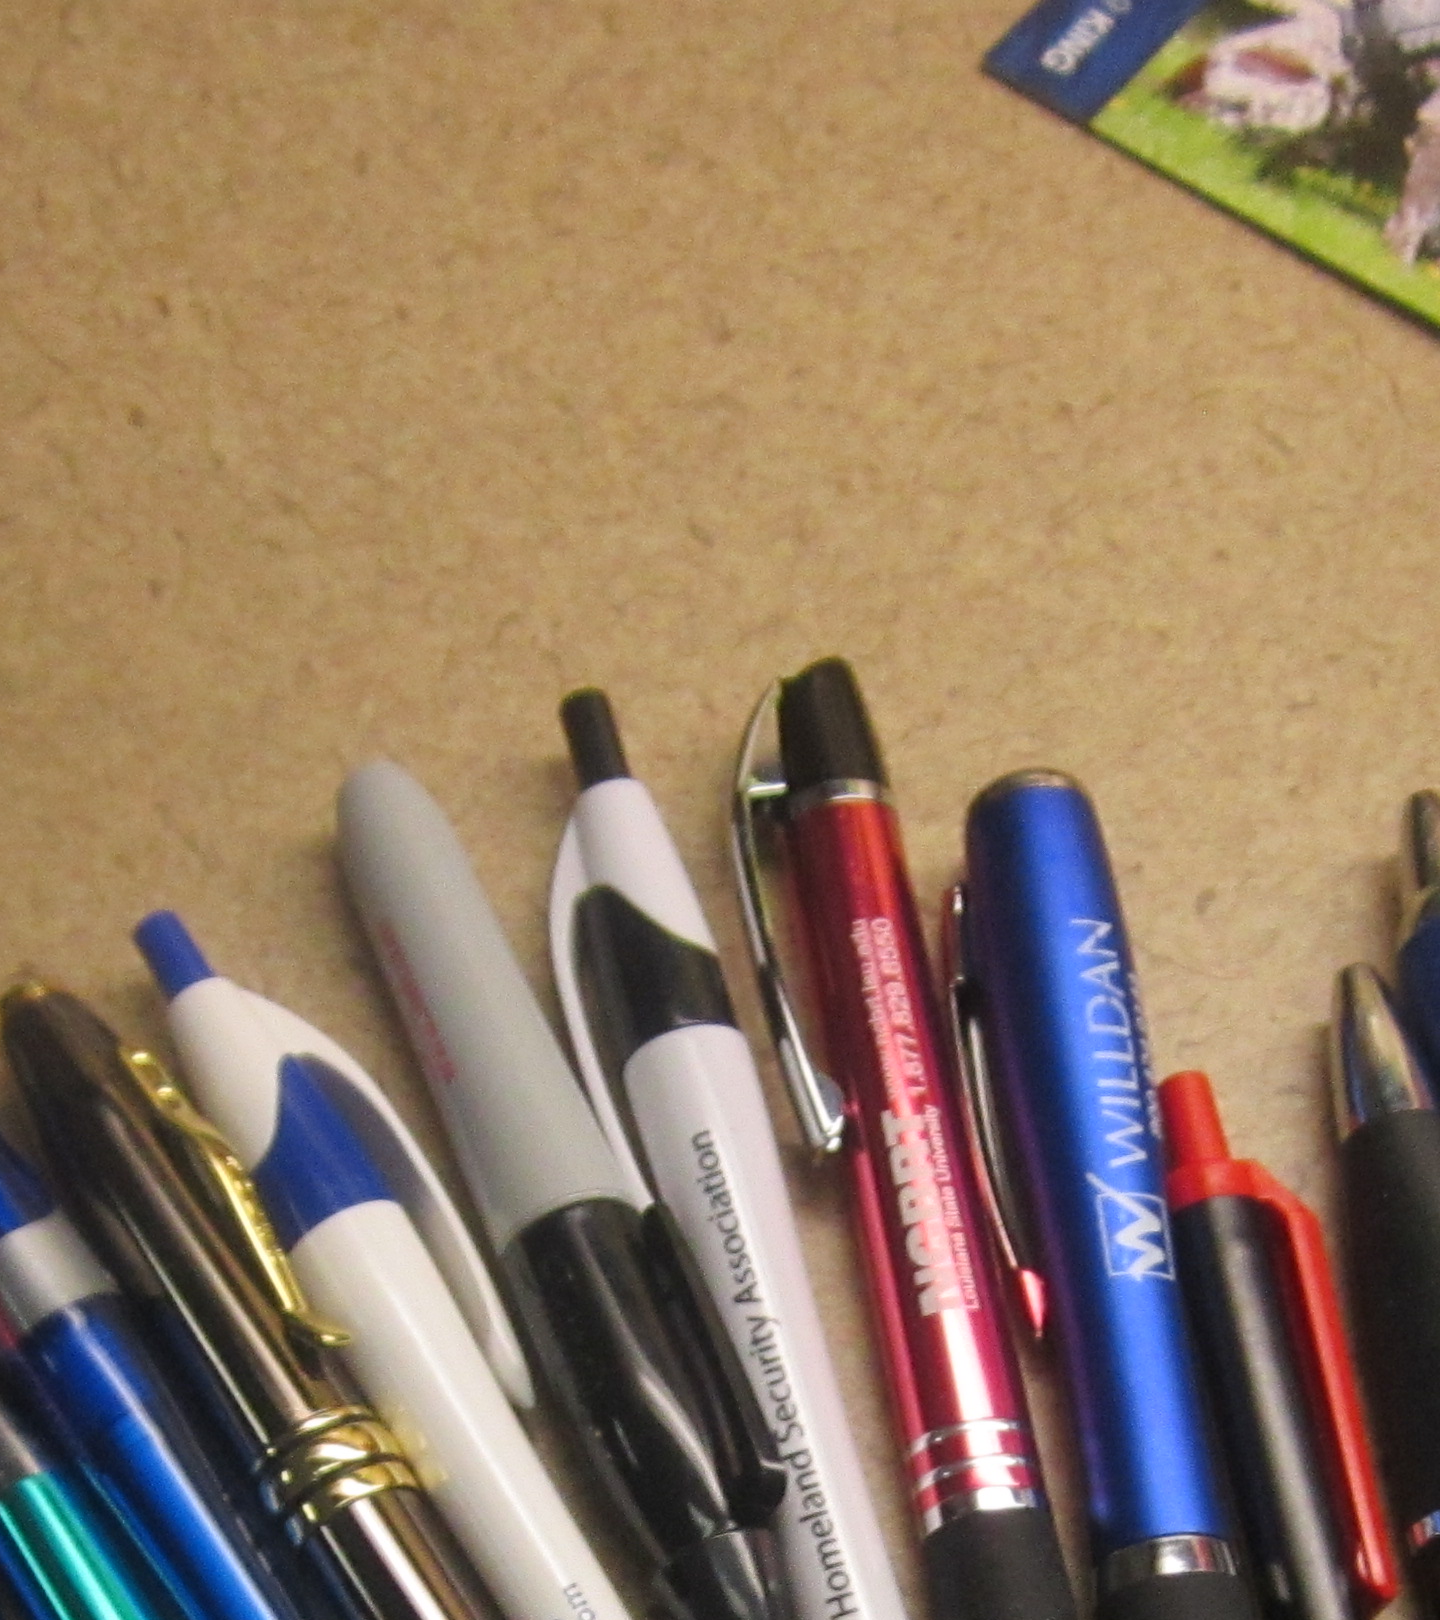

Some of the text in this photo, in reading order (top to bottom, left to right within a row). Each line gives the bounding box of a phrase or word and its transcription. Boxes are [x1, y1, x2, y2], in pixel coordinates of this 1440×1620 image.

[1071, 920, 1147, 1168] WILLDAN
[689, 1128, 762, 1301] Association
[744, 1320, 804, 1443] Security
[780, 1449, 858, 1620] Homeland
